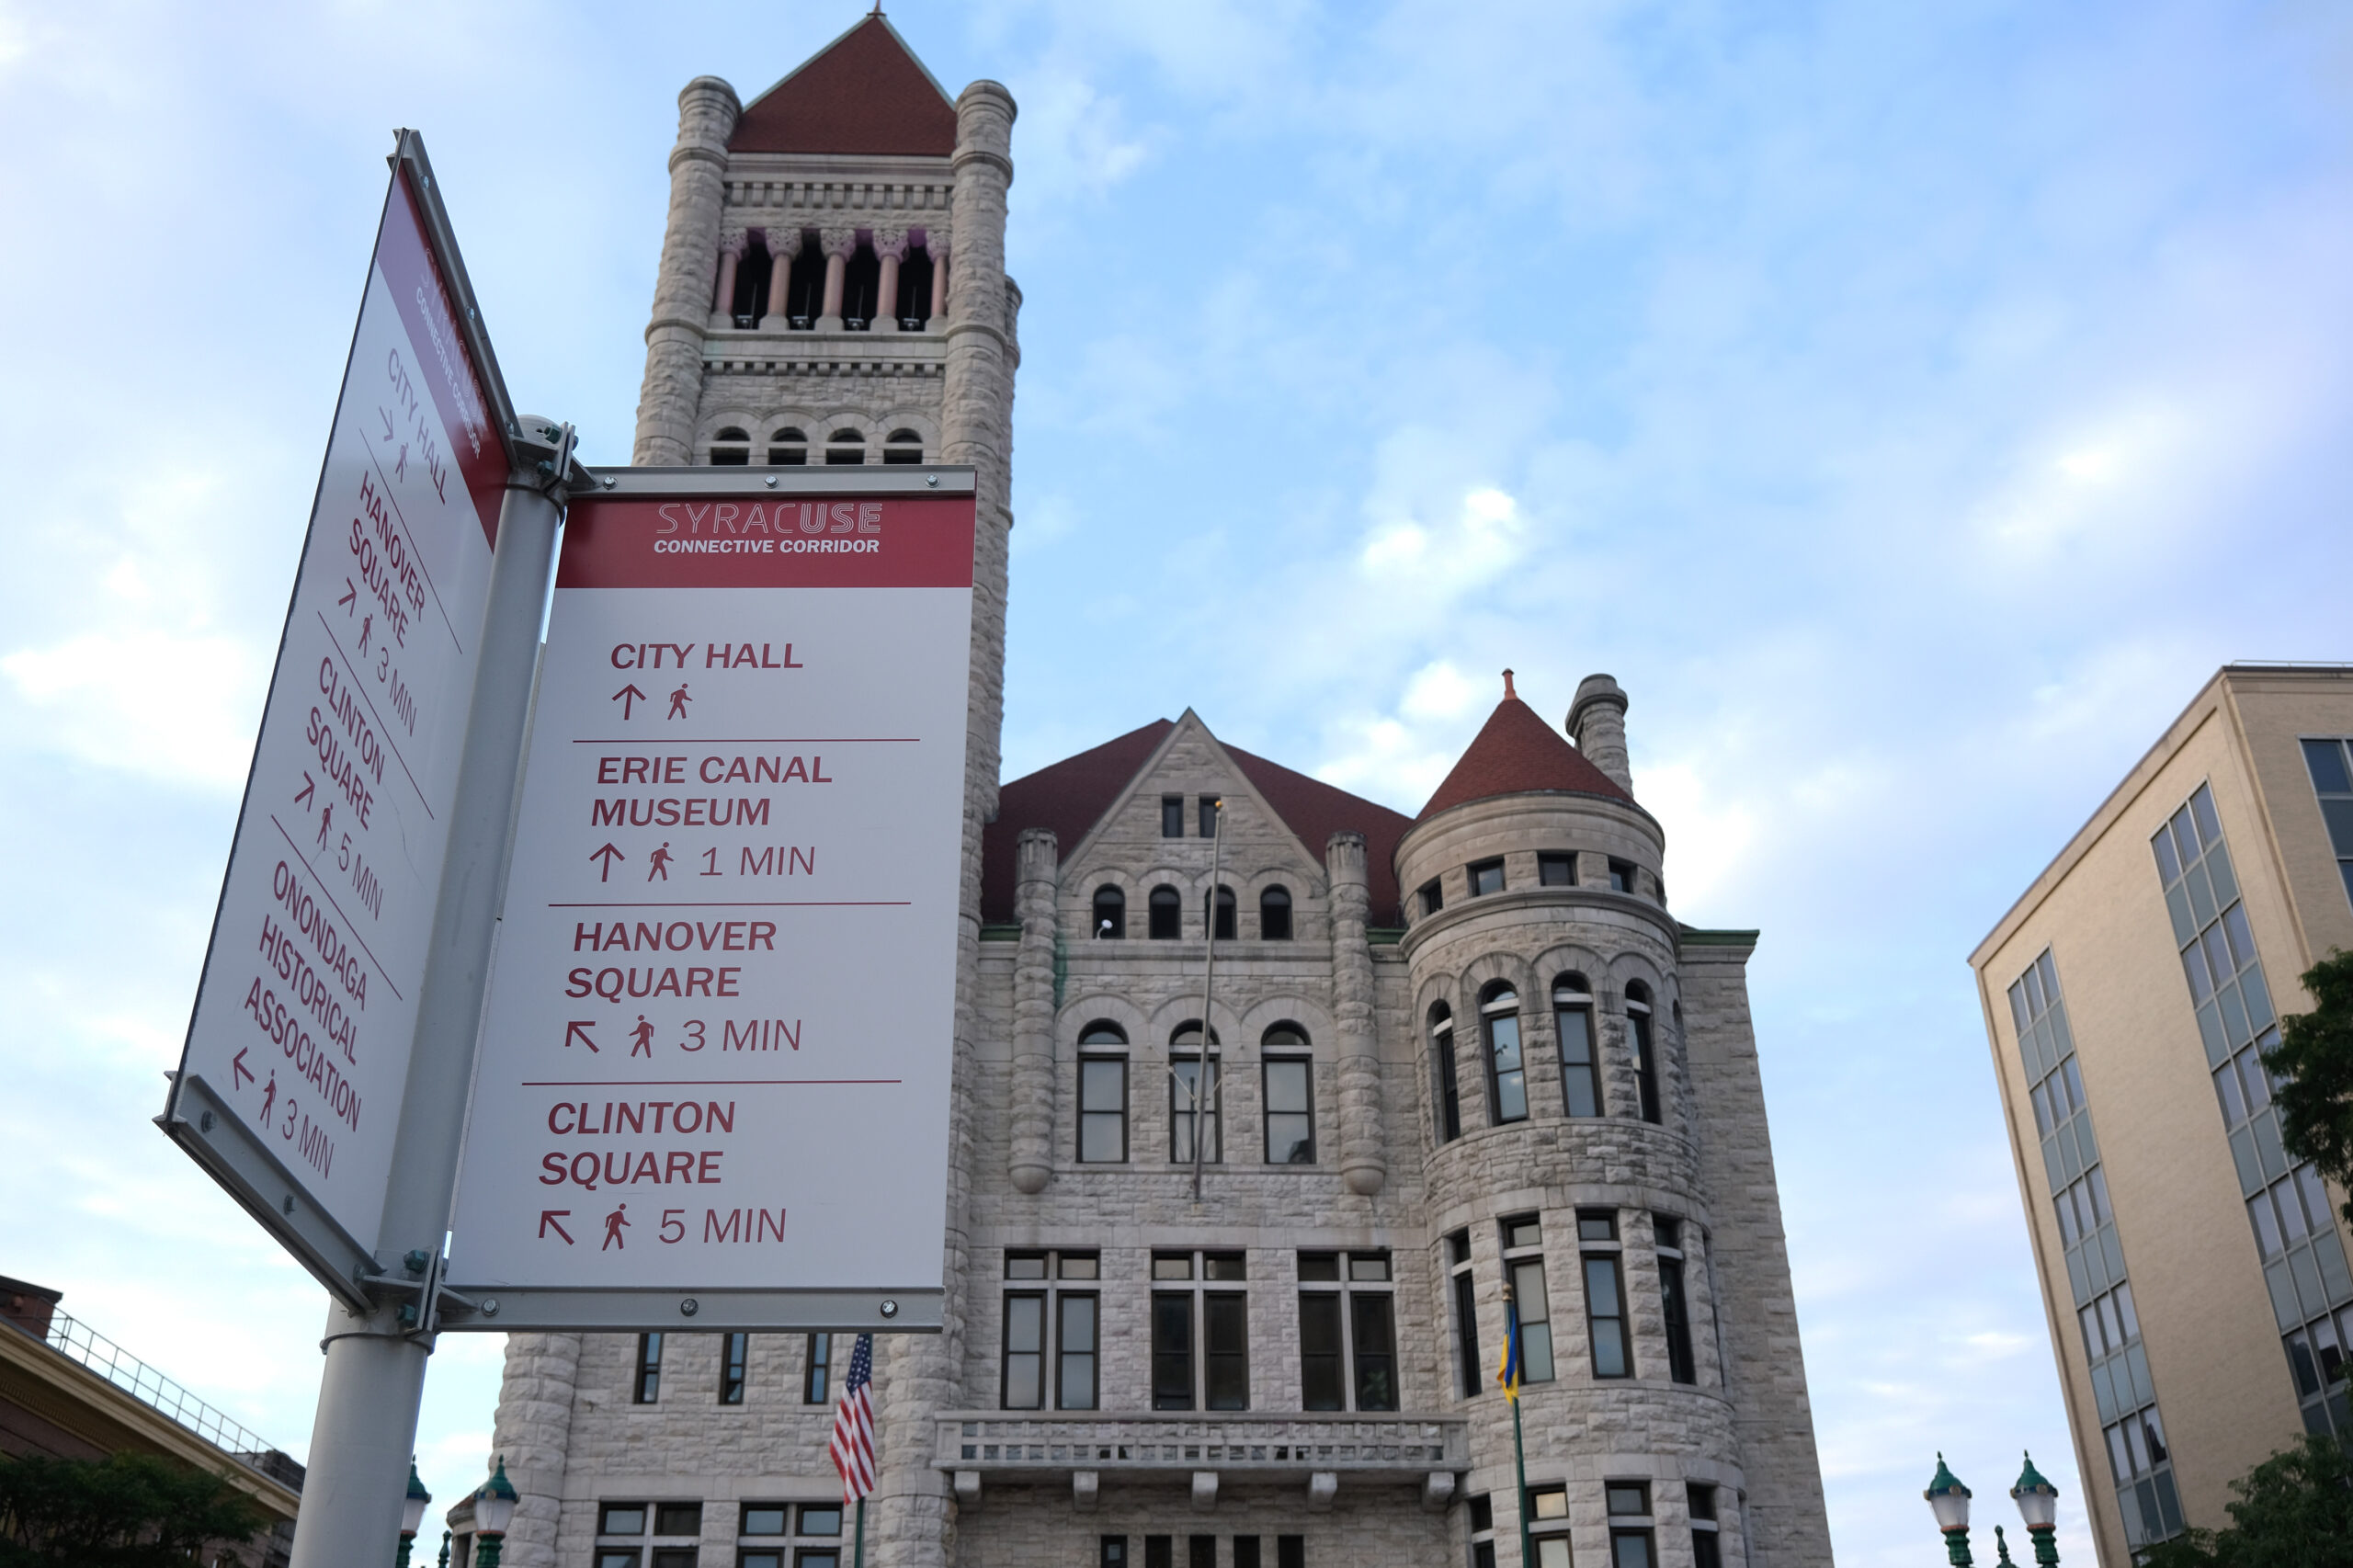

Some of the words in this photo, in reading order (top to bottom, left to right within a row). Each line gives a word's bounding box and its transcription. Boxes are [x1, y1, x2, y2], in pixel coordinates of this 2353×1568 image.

[416, 286, 453, 386] CONNECTIVE
[451, 380, 482, 460] CORRIDOR
[388, 347, 419, 423] CITY
[417, 415, 447, 506] HALL
[359, 470, 426, 622] HANOVER
[654, 540, 775, 553] CONNECTIVE
[779, 540, 880, 553] CORRIDOR
[655, 503, 883, 534] SYRACUSE
[349, 517, 409, 649] SQUARE
[611, 643, 696, 670] CITY
[706, 643, 805, 670] HALL
[319, 656, 385, 786] CLINTON
[377, 646, 390, 684] 3
[390, 668, 417, 737] MIN
[306, 706, 374, 832] SQUARE
[597, 757, 688, 784] ERIE
[700, 756, 834, 784] CANAL
[591, 799, 771, 827] MUSEUM
[338, 831, 352, 872] 5
[352, 852, 383, 922] MIN
[699, 847, 723, 877] 1
[741, 847, 816, 876] MIN
[273, 859, 367, 1012] ONONDAGA
[574, 922, 778, 952] HANOVER
[258, 913, 358, 1067] HISTORICAL
[564, 967, 743, 1004] SQUARE
[244, 975, 362, 1133] ASSOCIATION
[680, 1020, 707, 1052] 3
[723, 1020, 802, 1052] MIN
[282, 1098, 298, 1141] 3
[298, 1114, 335, 1180] MIN
[548, 1101, 736, 1135] CLINTON
[540, 1152, 724, 1192] SQUARE
[659, 1210, 686, 1244] 5
[705, 1209, 788, 1244] MIN
